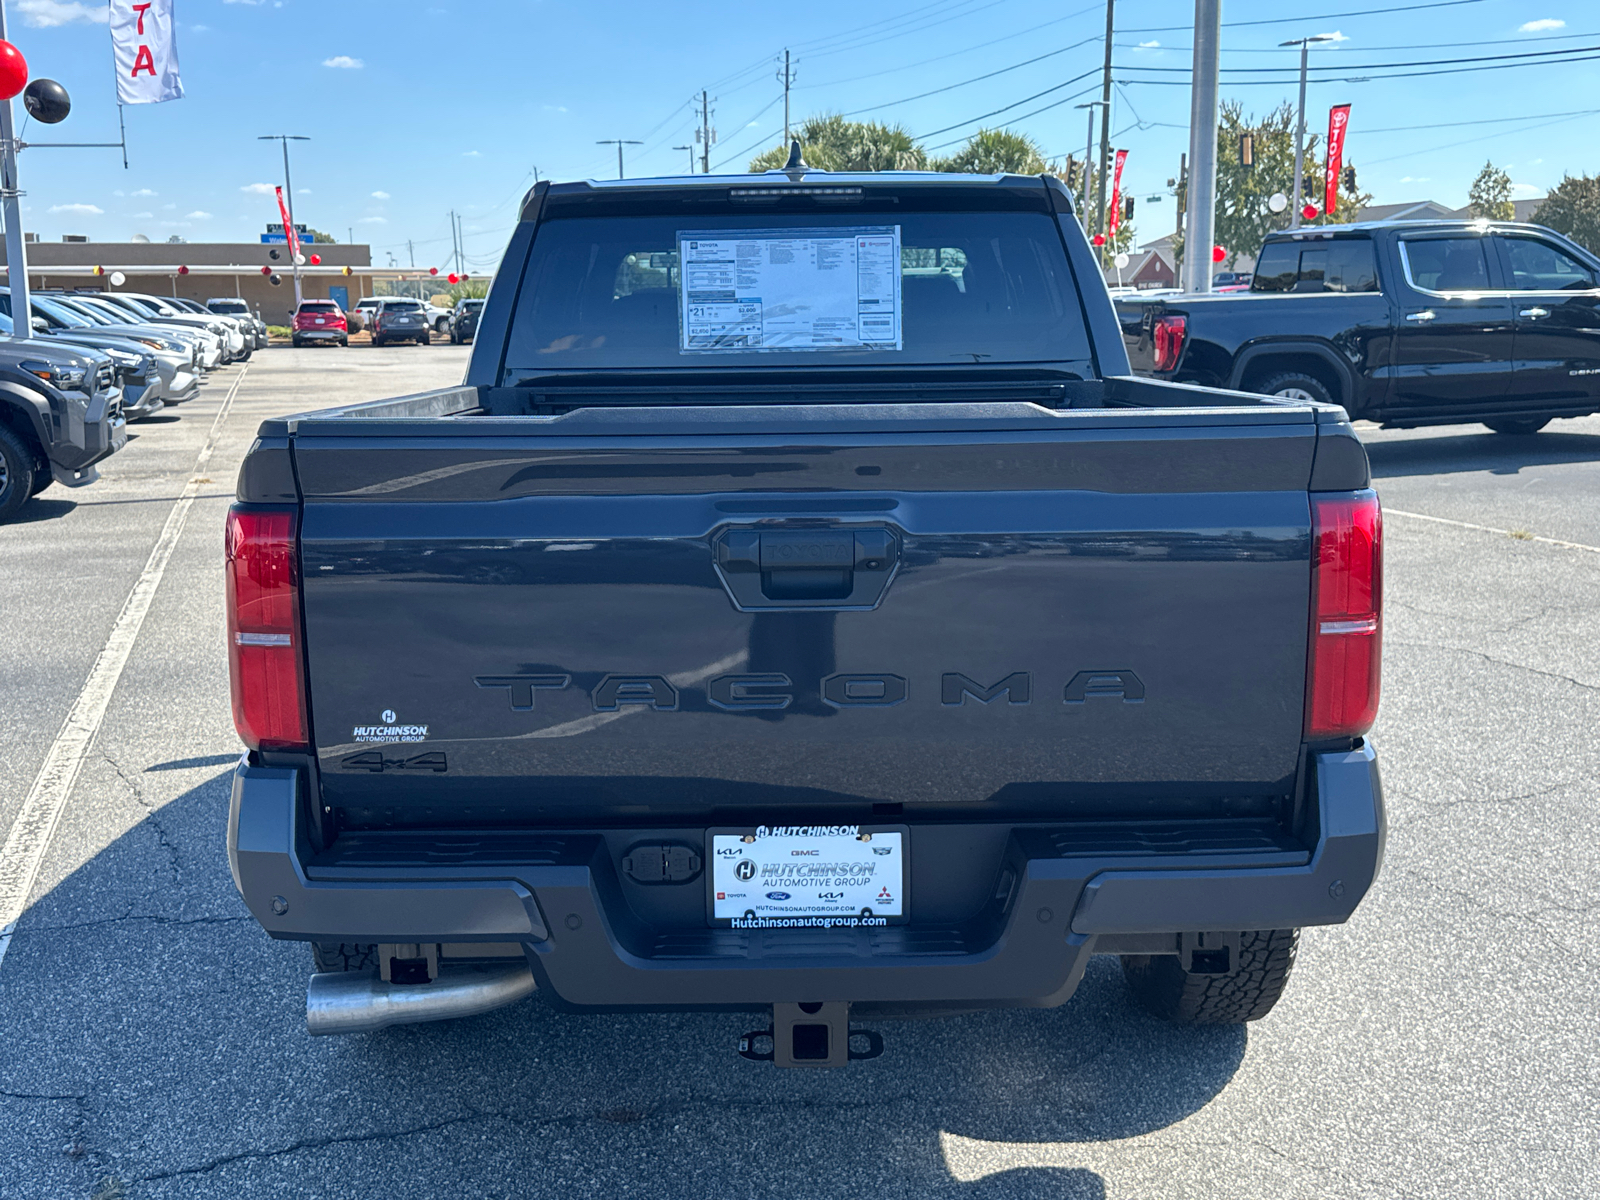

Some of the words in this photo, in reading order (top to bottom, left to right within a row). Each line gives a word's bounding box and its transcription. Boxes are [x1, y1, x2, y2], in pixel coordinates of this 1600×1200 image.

[693, 307, 705, 317] 21
[766, 544, 848, 559] TOYOTA
[471, 670, 1146, 711] TACOMA
[353, 726, 428, 736] HUTCHINSON
[355, 735, 400, 743] AUTOMOTIVE
[771, 825, 859, 838] HUTCHINSON
[717, 848, 742, 856] KIA
[760, 862, 877, 878] HUTCHINSON
[762, 878, 831, 887] AUTOMOTIVE
[834, 877, 871, 887] GROUP
[769, 892, 787, 900] Ford
[731, 917, 887, 928] Hutchinsonautogroup.com
